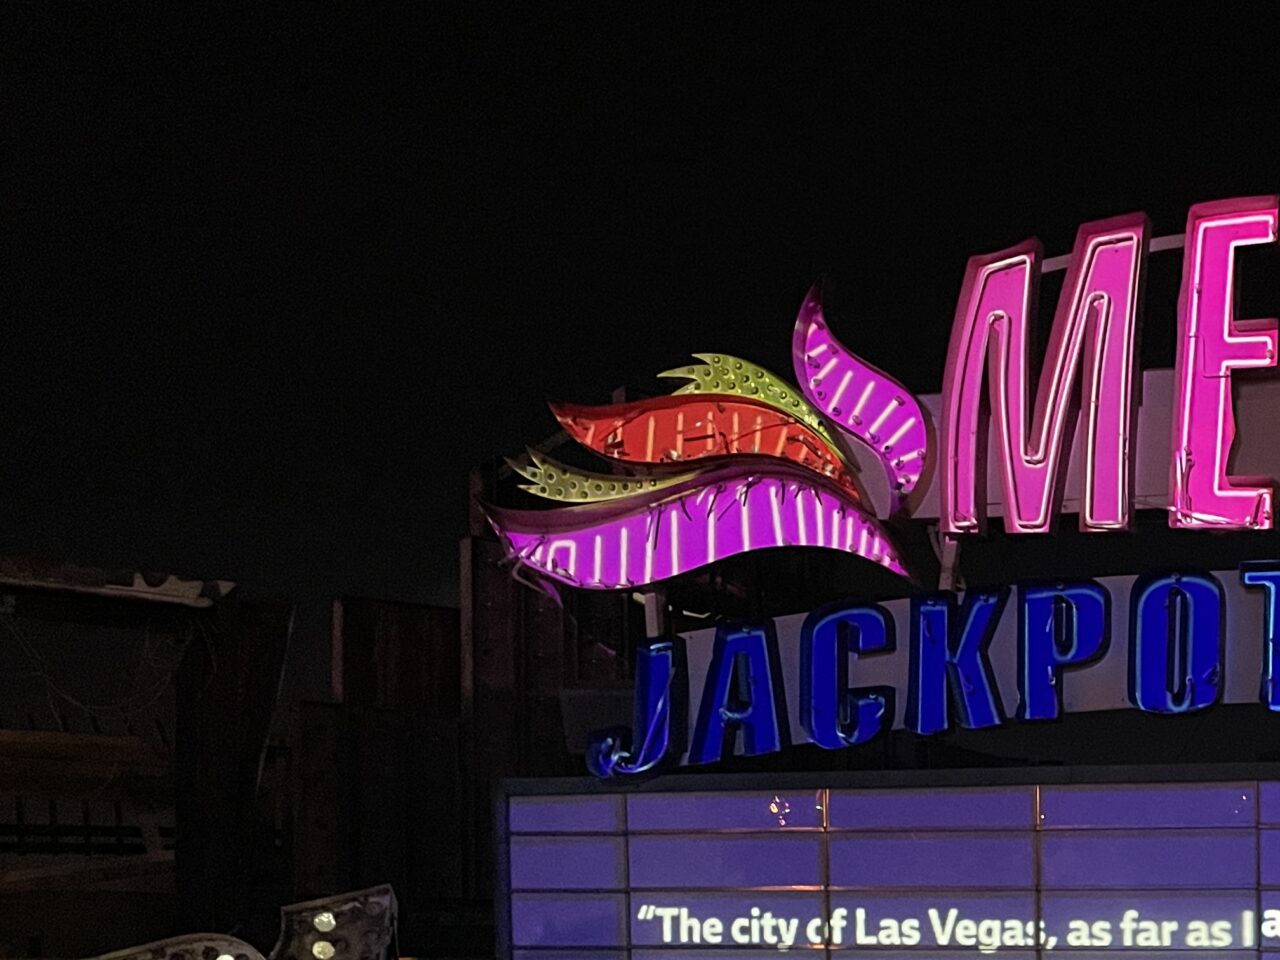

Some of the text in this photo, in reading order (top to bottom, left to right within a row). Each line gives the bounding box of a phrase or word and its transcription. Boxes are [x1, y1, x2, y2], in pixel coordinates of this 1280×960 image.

[731, 908, 798, 951] city
[806, 908, 847, 944] of
[856, 908, 921, 945] Las
[929, 909, 1057, 950] Vegas,
[1067, 918, 1112, 947] as
[1121, 910, 1178, 947] far
[1187, 919, 1232, 947] as
[1243, 911, 1254, 947] I
